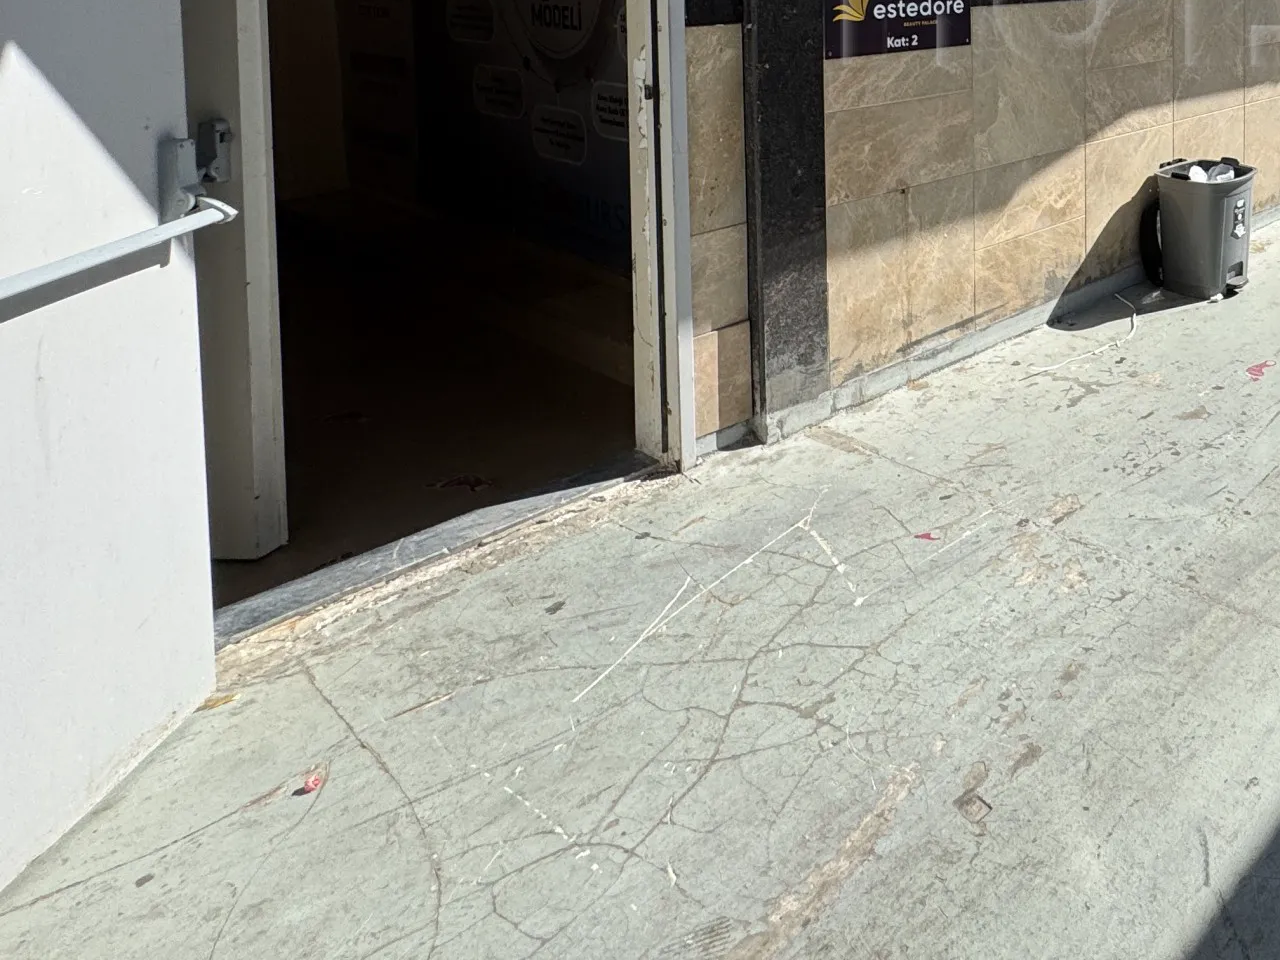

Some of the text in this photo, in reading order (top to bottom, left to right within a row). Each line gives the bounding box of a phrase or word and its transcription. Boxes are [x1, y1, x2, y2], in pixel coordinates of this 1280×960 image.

[531, 2, 582, 31] MODELİ
[887, 35, 919, 49] Kat: 2
